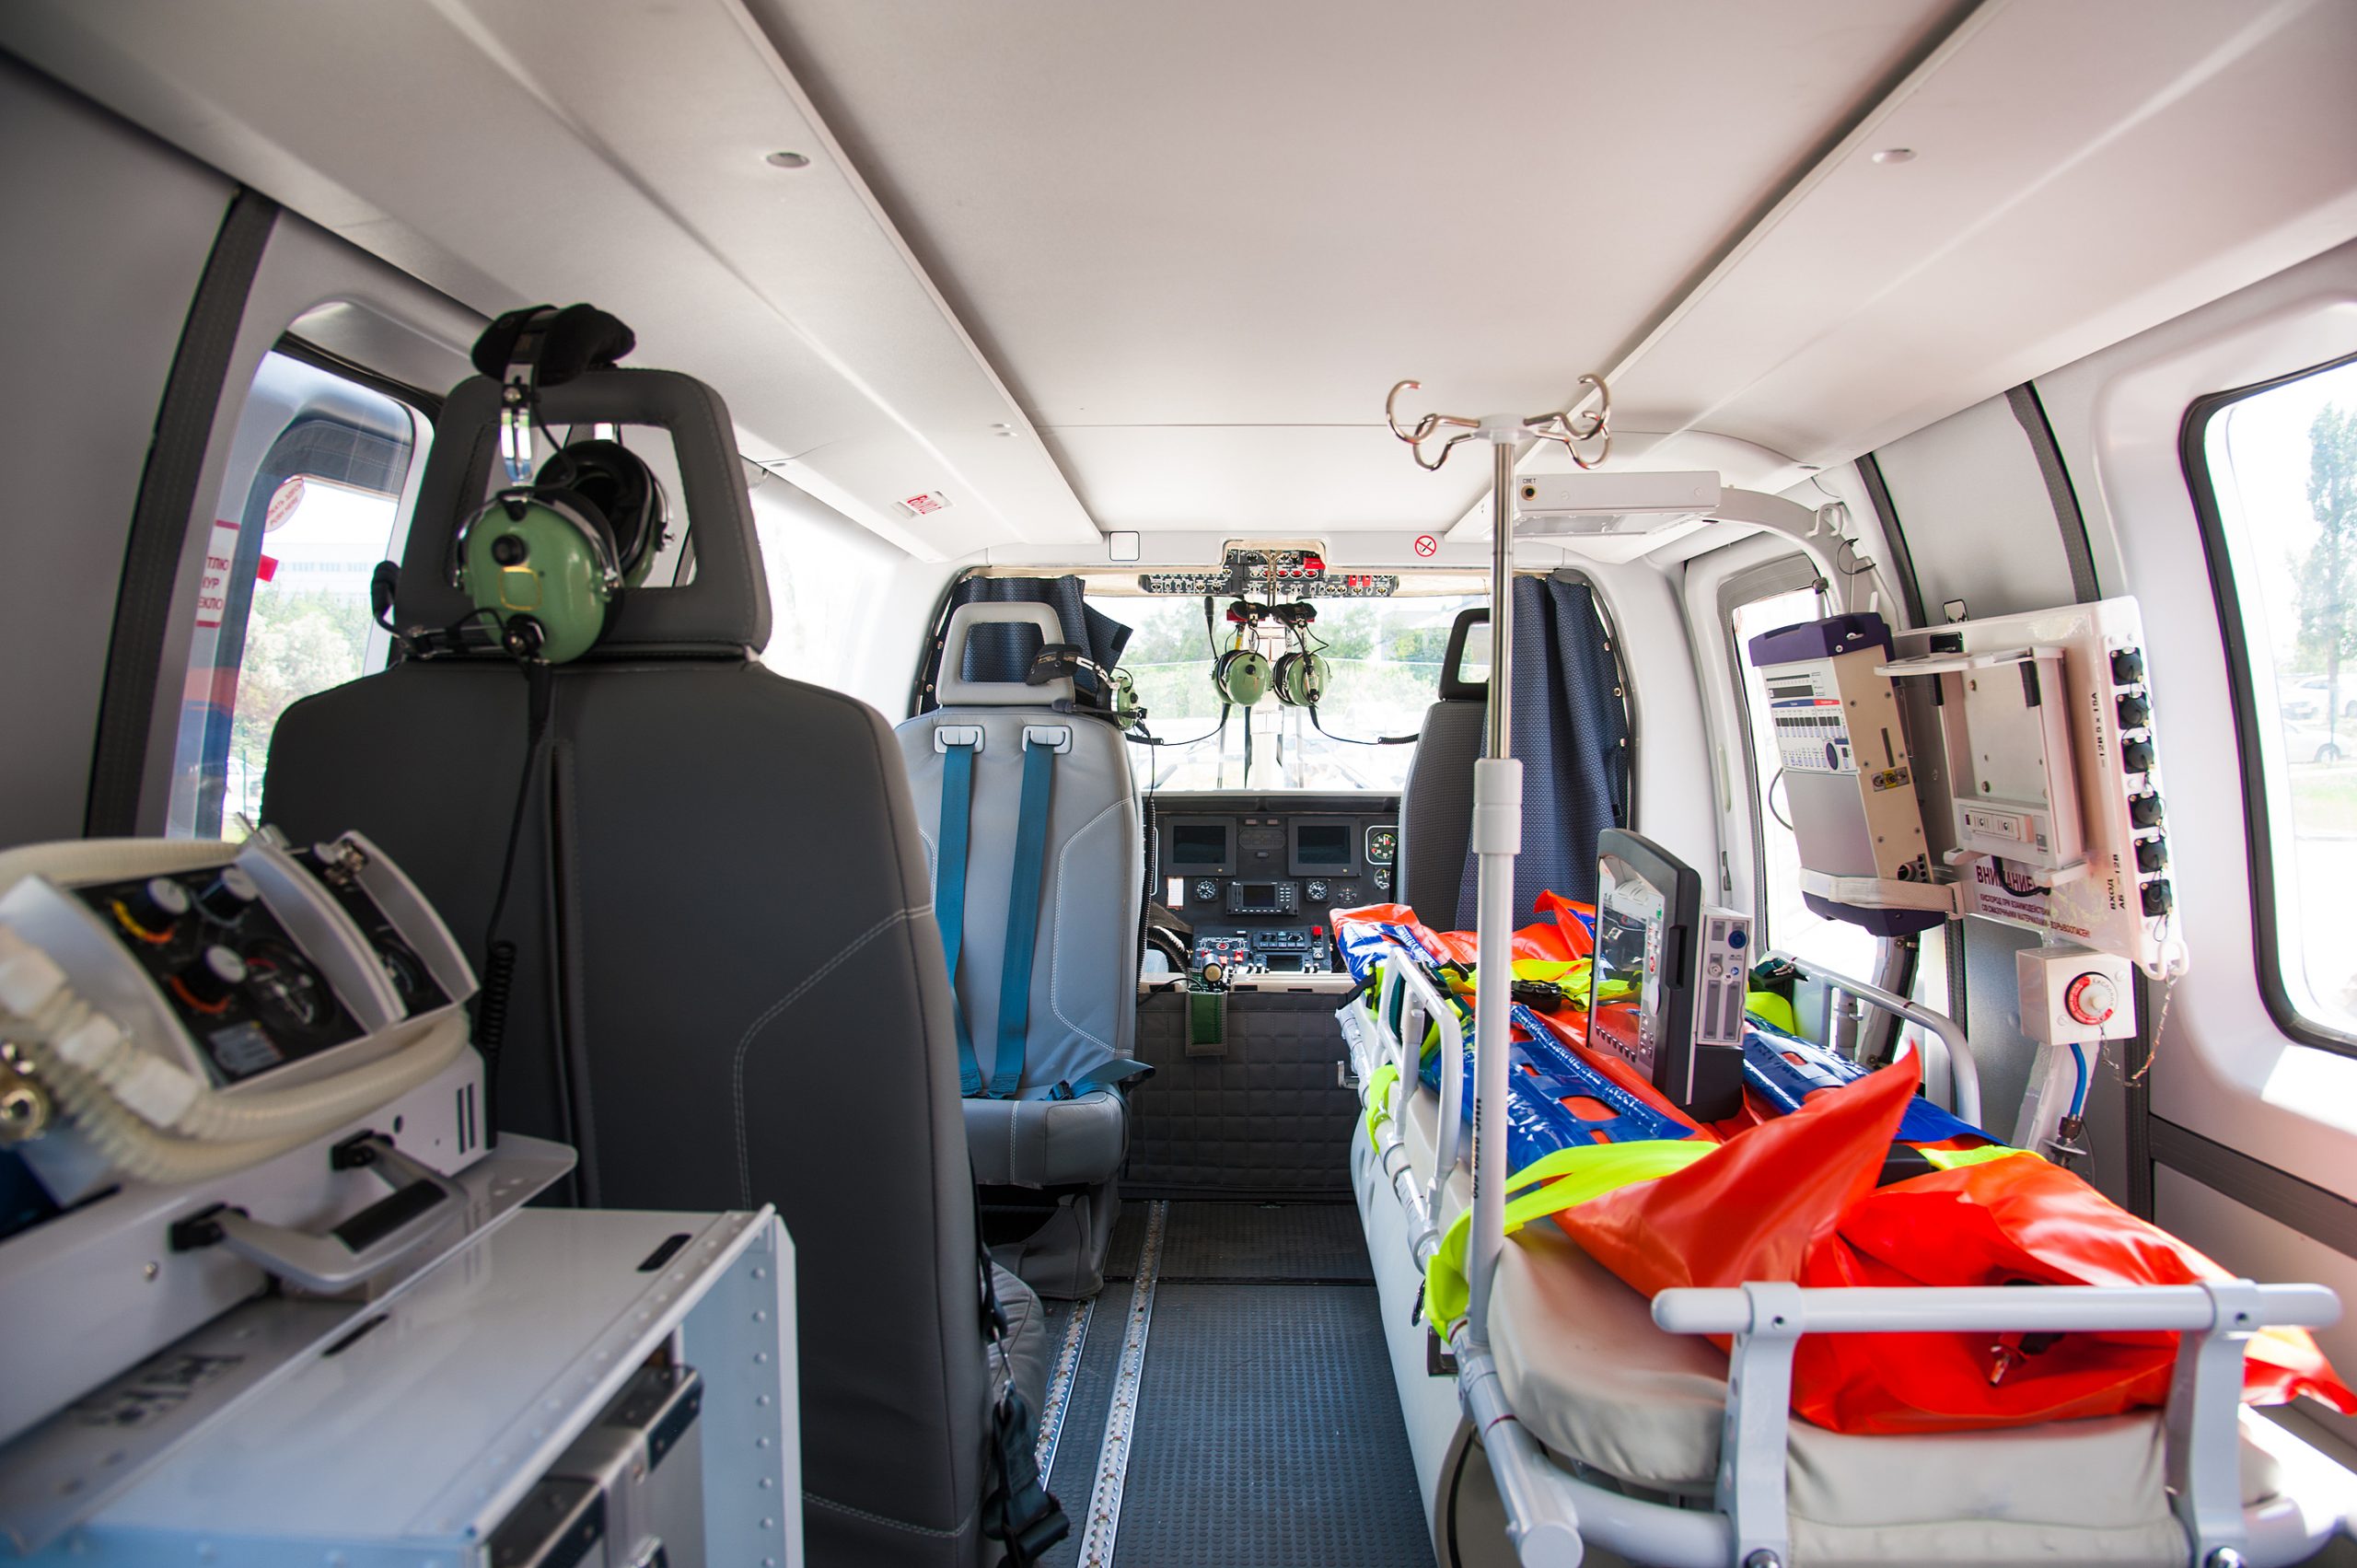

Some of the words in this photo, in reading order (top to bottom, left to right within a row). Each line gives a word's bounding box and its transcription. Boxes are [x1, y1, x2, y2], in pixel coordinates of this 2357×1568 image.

[1980, 893, 2003, 906] КИСЛОРОД
[2002, 898, 2011, 909] ПРИ
[2107, 878, 2117, 911] ВХОД
